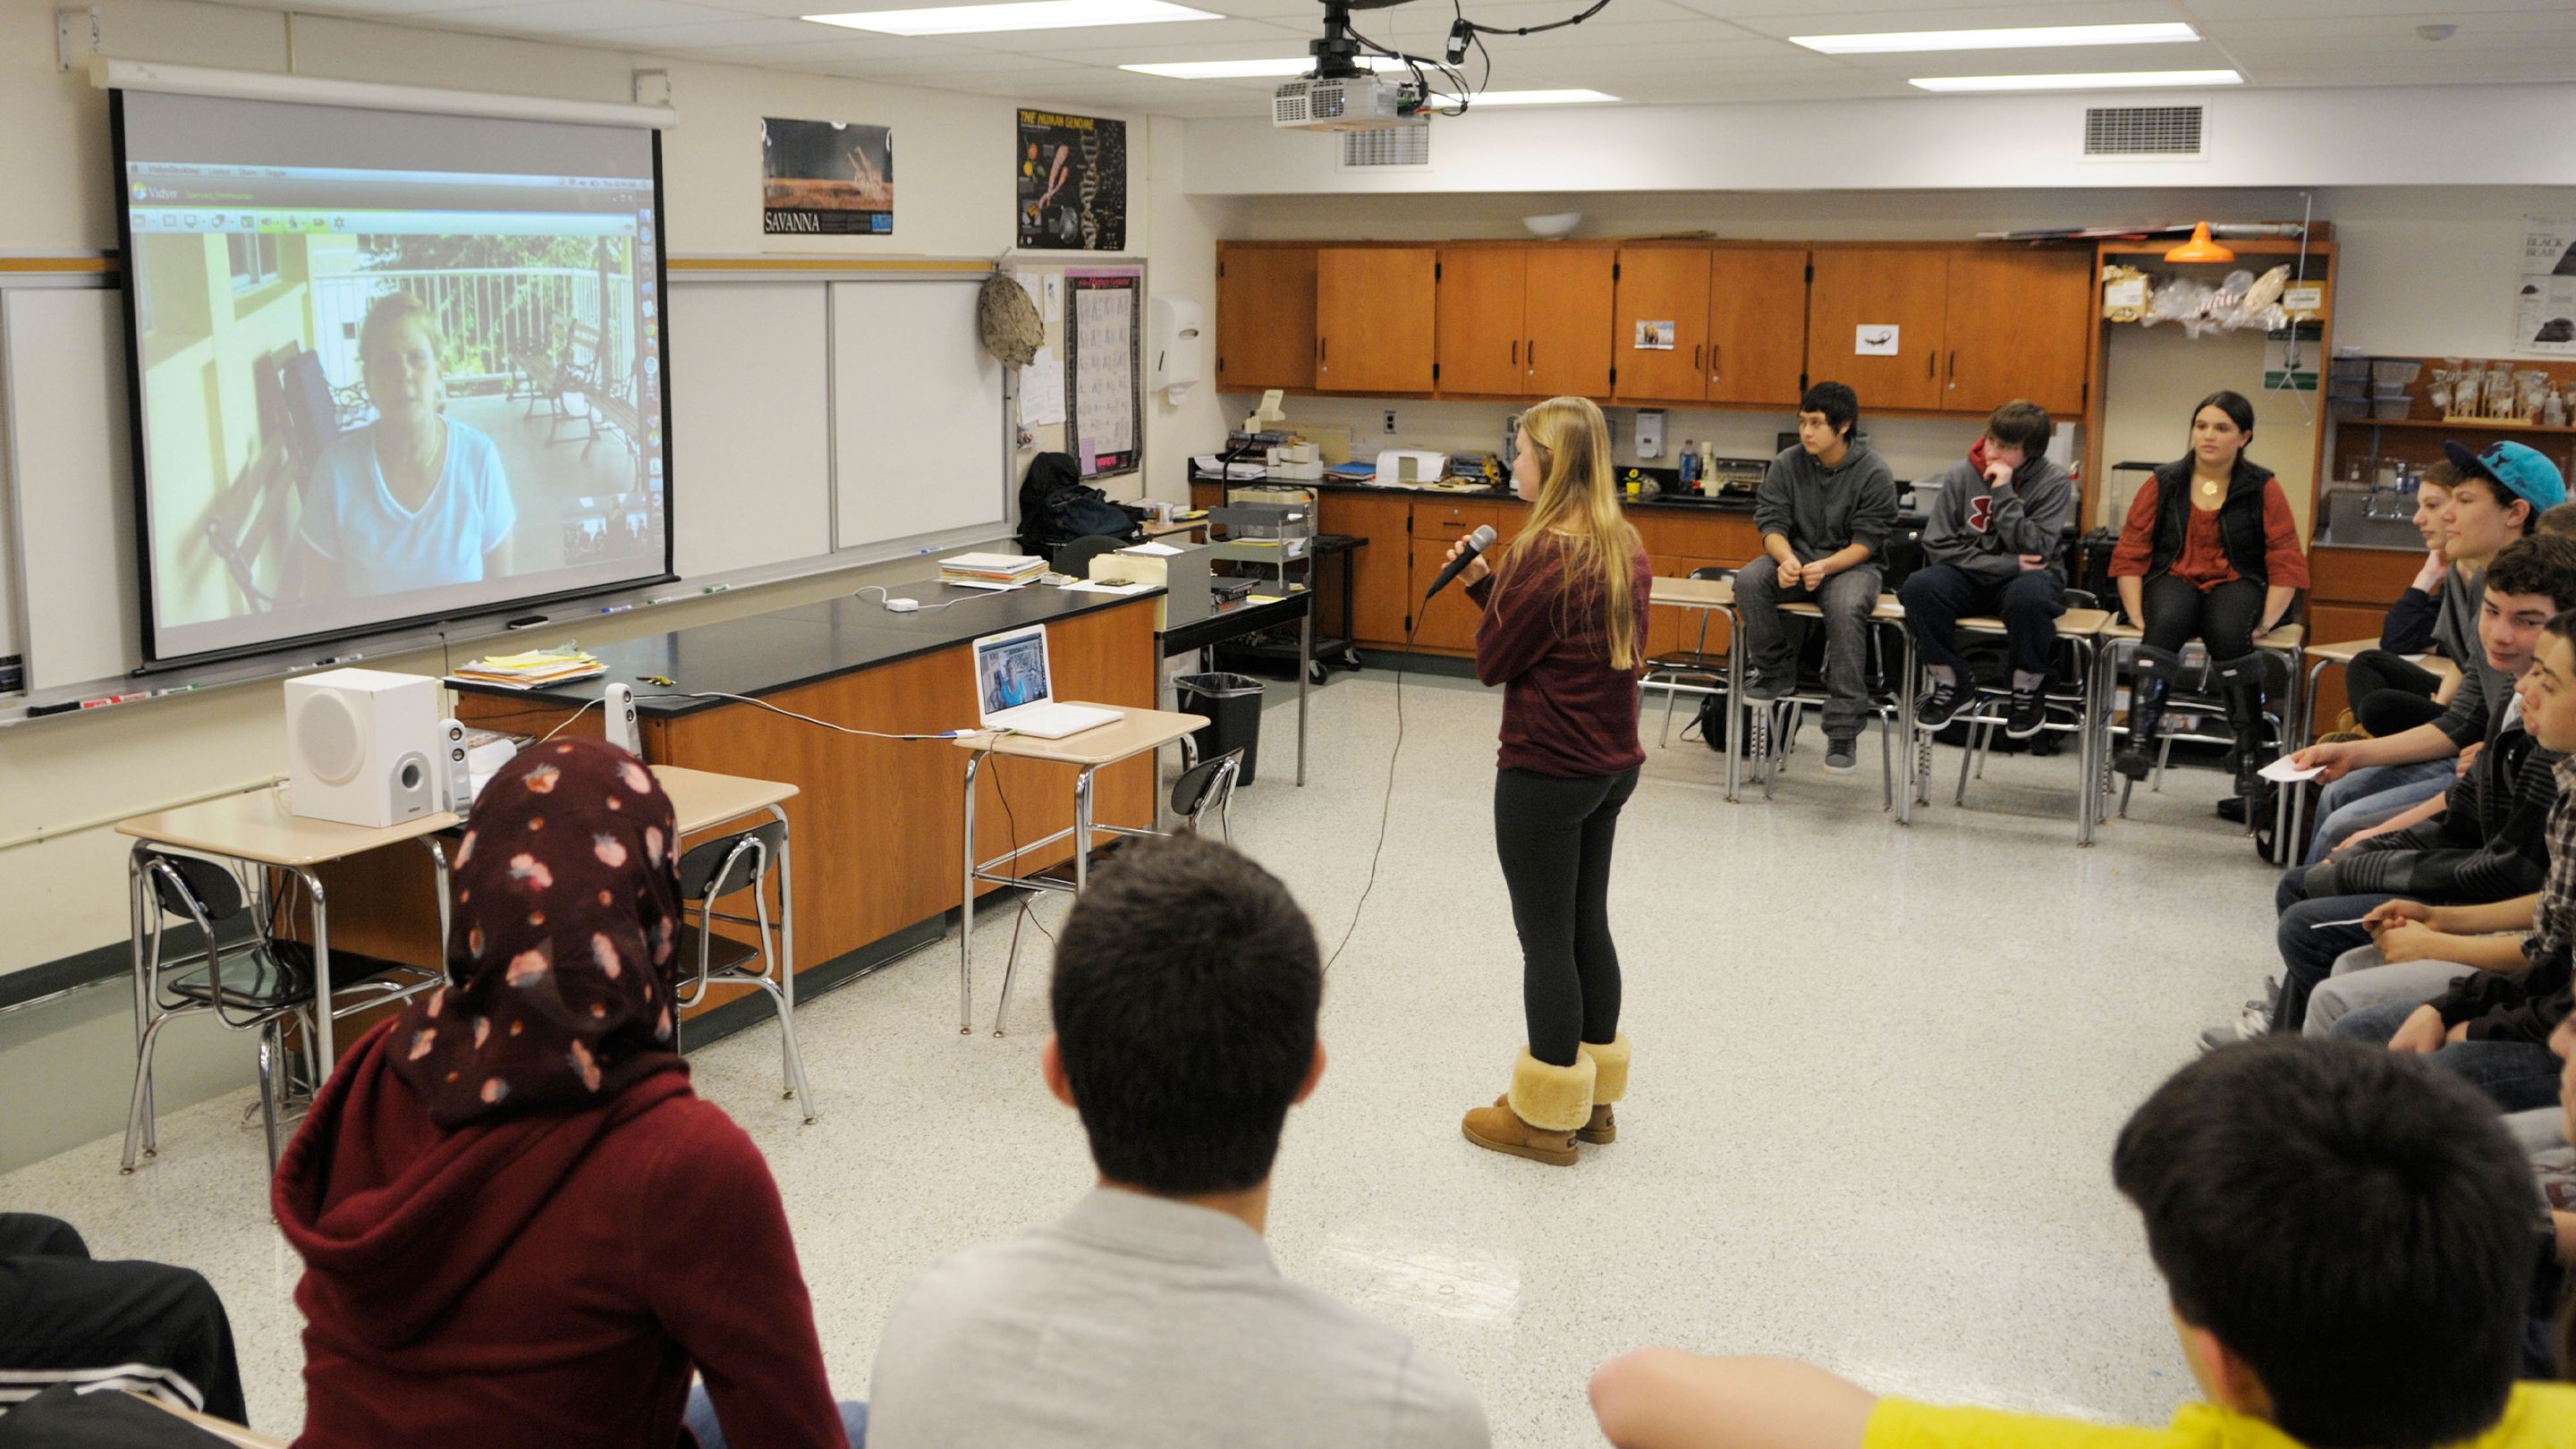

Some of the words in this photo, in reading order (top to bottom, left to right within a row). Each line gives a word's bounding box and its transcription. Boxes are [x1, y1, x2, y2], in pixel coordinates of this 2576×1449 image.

[1021, 110, 1037, 123] THE
[1038, 113, 1064, 126] HUMAN
[1065, 115, 1095, 131] GENOME
[148, 186, 178, 199] Vidyo
[765, 211, 820, 233] SAVANNA
[2527, 237, 2563, 247] BLACK
[2525, 248, 2556, 257] BEAR
